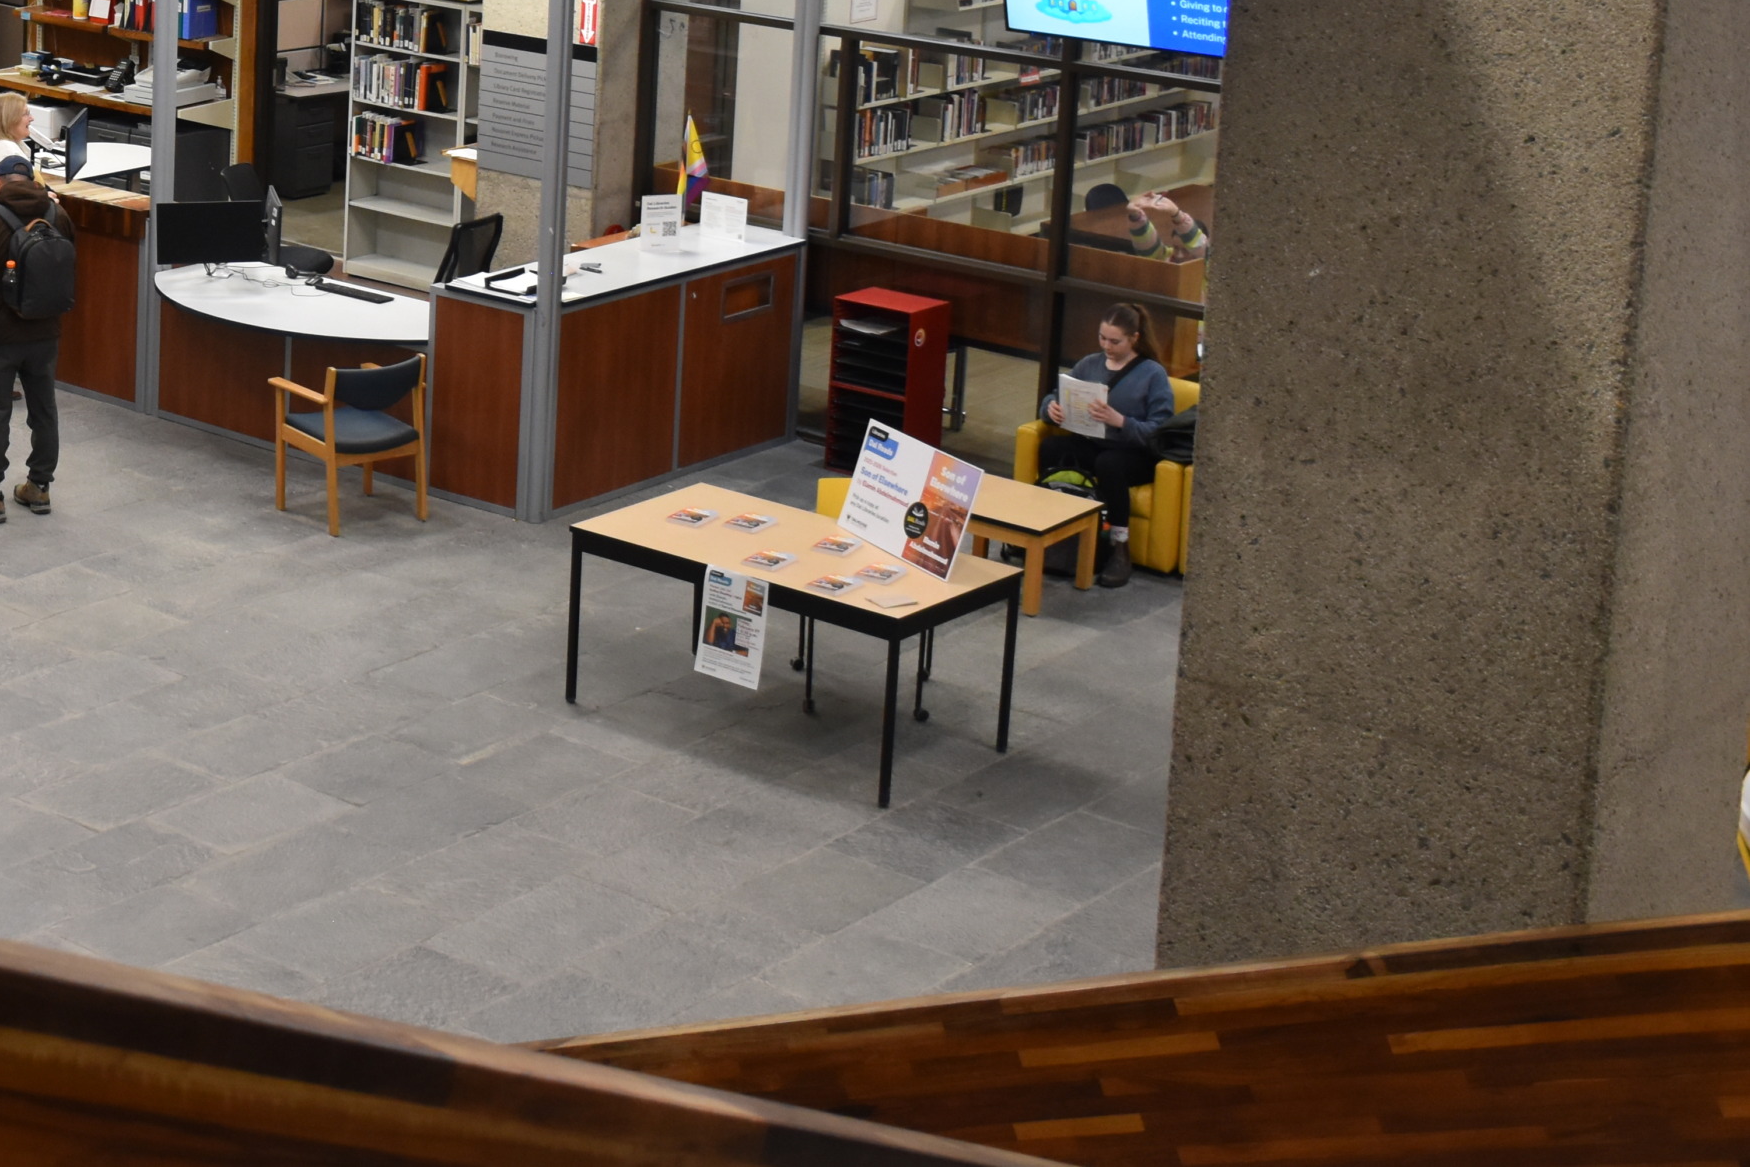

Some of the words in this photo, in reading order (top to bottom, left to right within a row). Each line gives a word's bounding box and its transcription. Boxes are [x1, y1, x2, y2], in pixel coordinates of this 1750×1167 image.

[1179, 0, 1210, 13] Giving
[1212, 4, 1222, 13] to
[1181, 15, 1220, 29] Reciting
[861, 466, 872, 478] Son
[872, 473, 879, 481] of
[878, 474, 908, 495] Elsewhere
[940, 466, 955, 481] Son
[956, 474, 967, 486] of
[930, 477, 969, 503] Elsewhere
